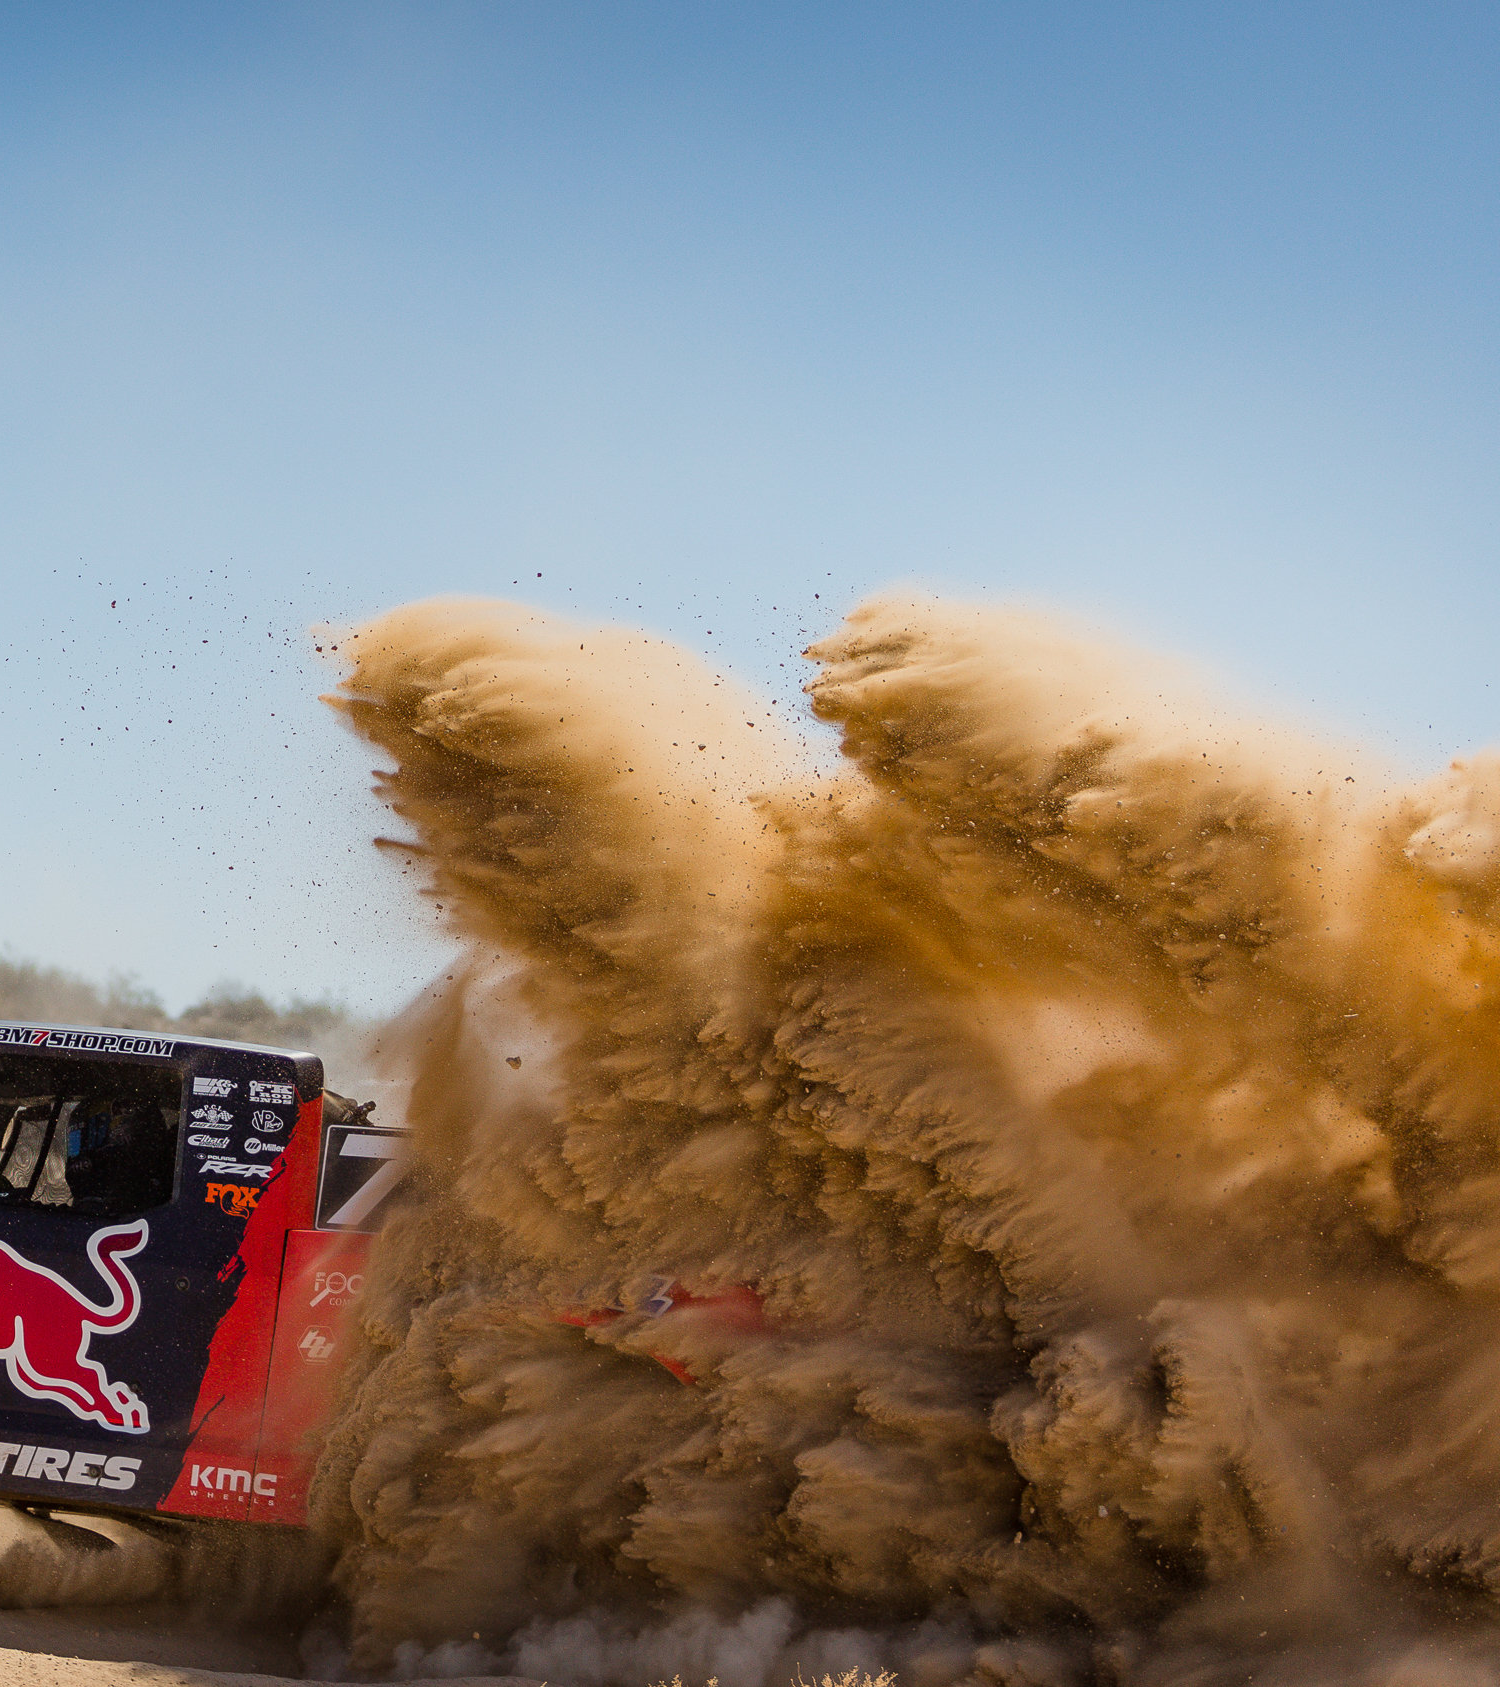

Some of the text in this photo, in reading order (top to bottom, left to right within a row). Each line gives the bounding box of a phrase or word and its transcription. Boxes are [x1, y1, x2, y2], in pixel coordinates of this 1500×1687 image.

[249, 1096, 293, 1105] ENDS
[262, 1143, 285, 1153] Miller
[207, 1154, 237, 1162] POLARIS
[198, 1160, 274, 1179] RZR
[204, 1182, 260, 1219] FOX
[190, 1490, 275, 1506] WHEELS
